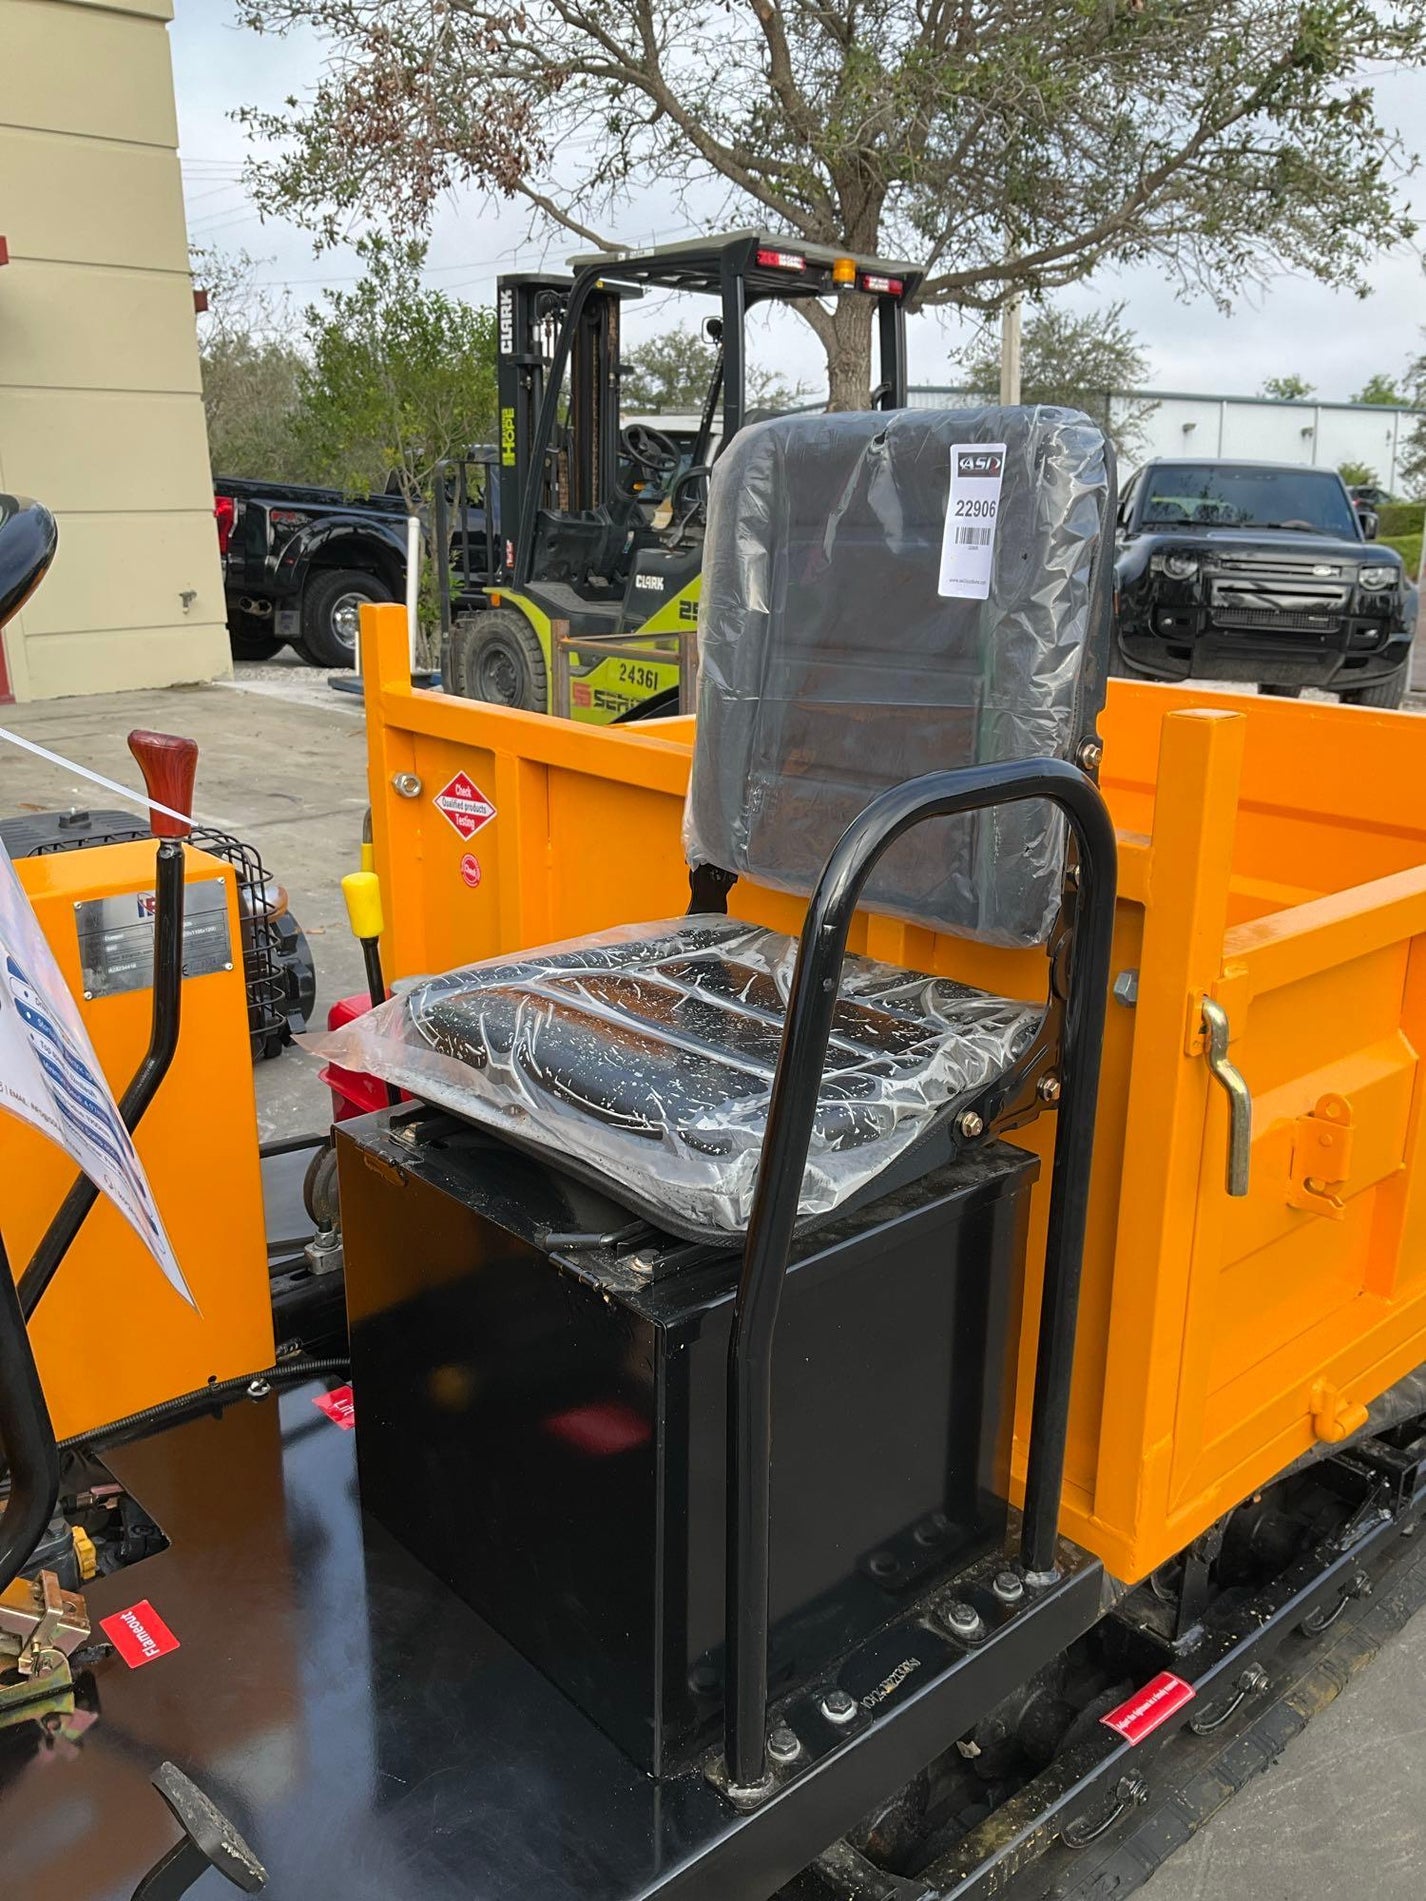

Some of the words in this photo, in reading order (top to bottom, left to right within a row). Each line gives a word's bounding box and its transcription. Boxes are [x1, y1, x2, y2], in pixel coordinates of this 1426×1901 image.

[501, 289, 513, 354] CLARK
[955, 500, 997, 517] 22906
[635, 574, 665, 591] CLARK
[618, 663, 658, 691] 24361
[455, 783, 472, 798] Check
[455, 813, 475, 831] Testing
[120, 1610, 160, 1657] Flameout
